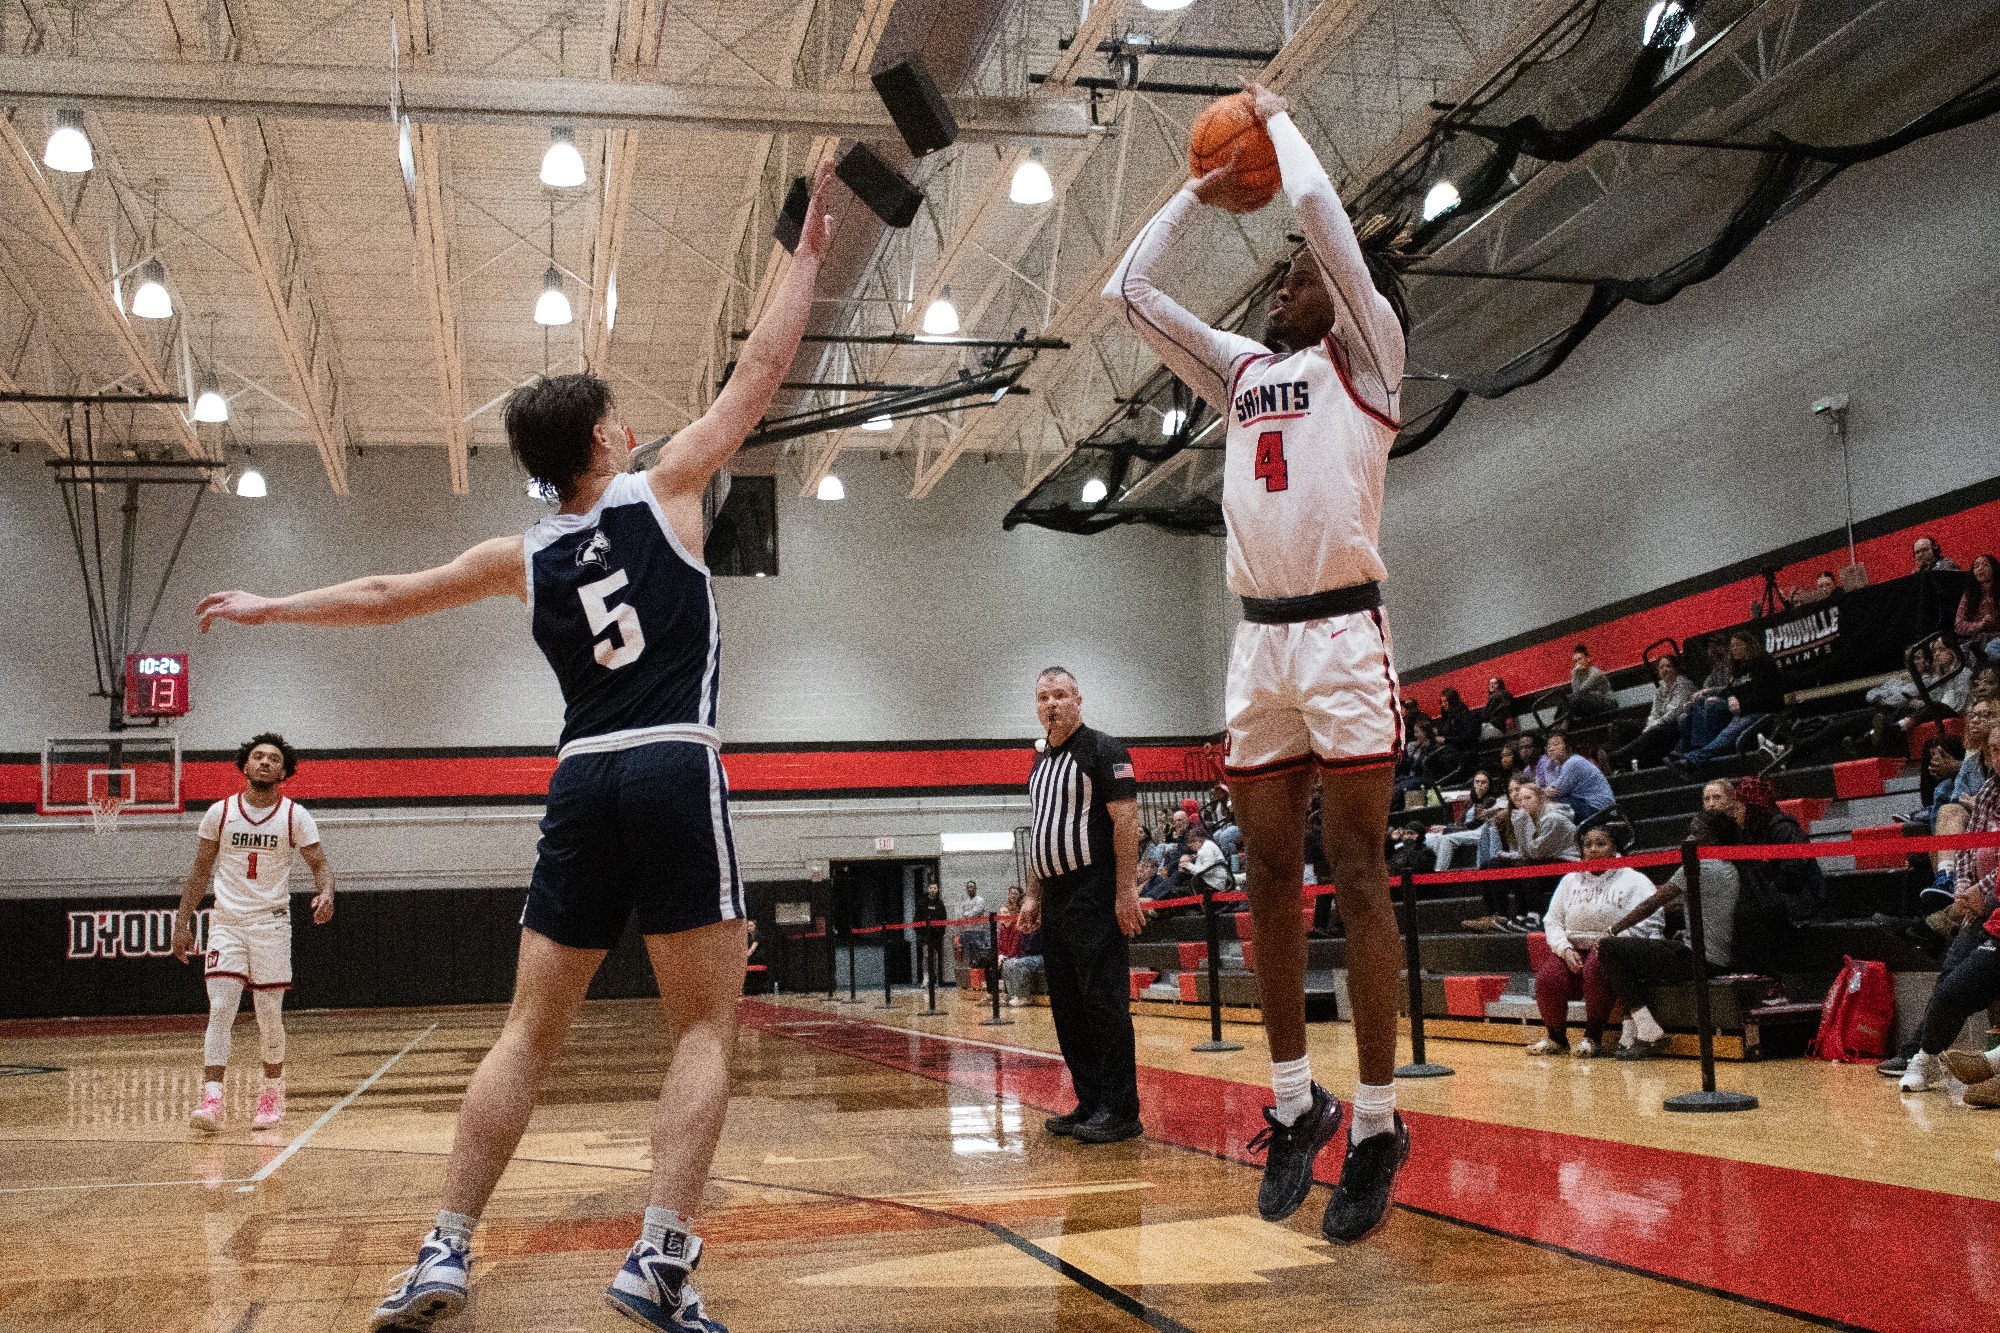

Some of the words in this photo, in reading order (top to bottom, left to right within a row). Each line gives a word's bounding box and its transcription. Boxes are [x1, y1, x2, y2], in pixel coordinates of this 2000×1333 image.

[1255, 431, 1288, 493] 4
[577, 568, 646, 670] 5
[139, 657, 181, 675] 10:26
[1776, 644, 1832, 669] SAINTS
[151, 679, 175, 707] 13
[246, 852, 258, 880] 1
